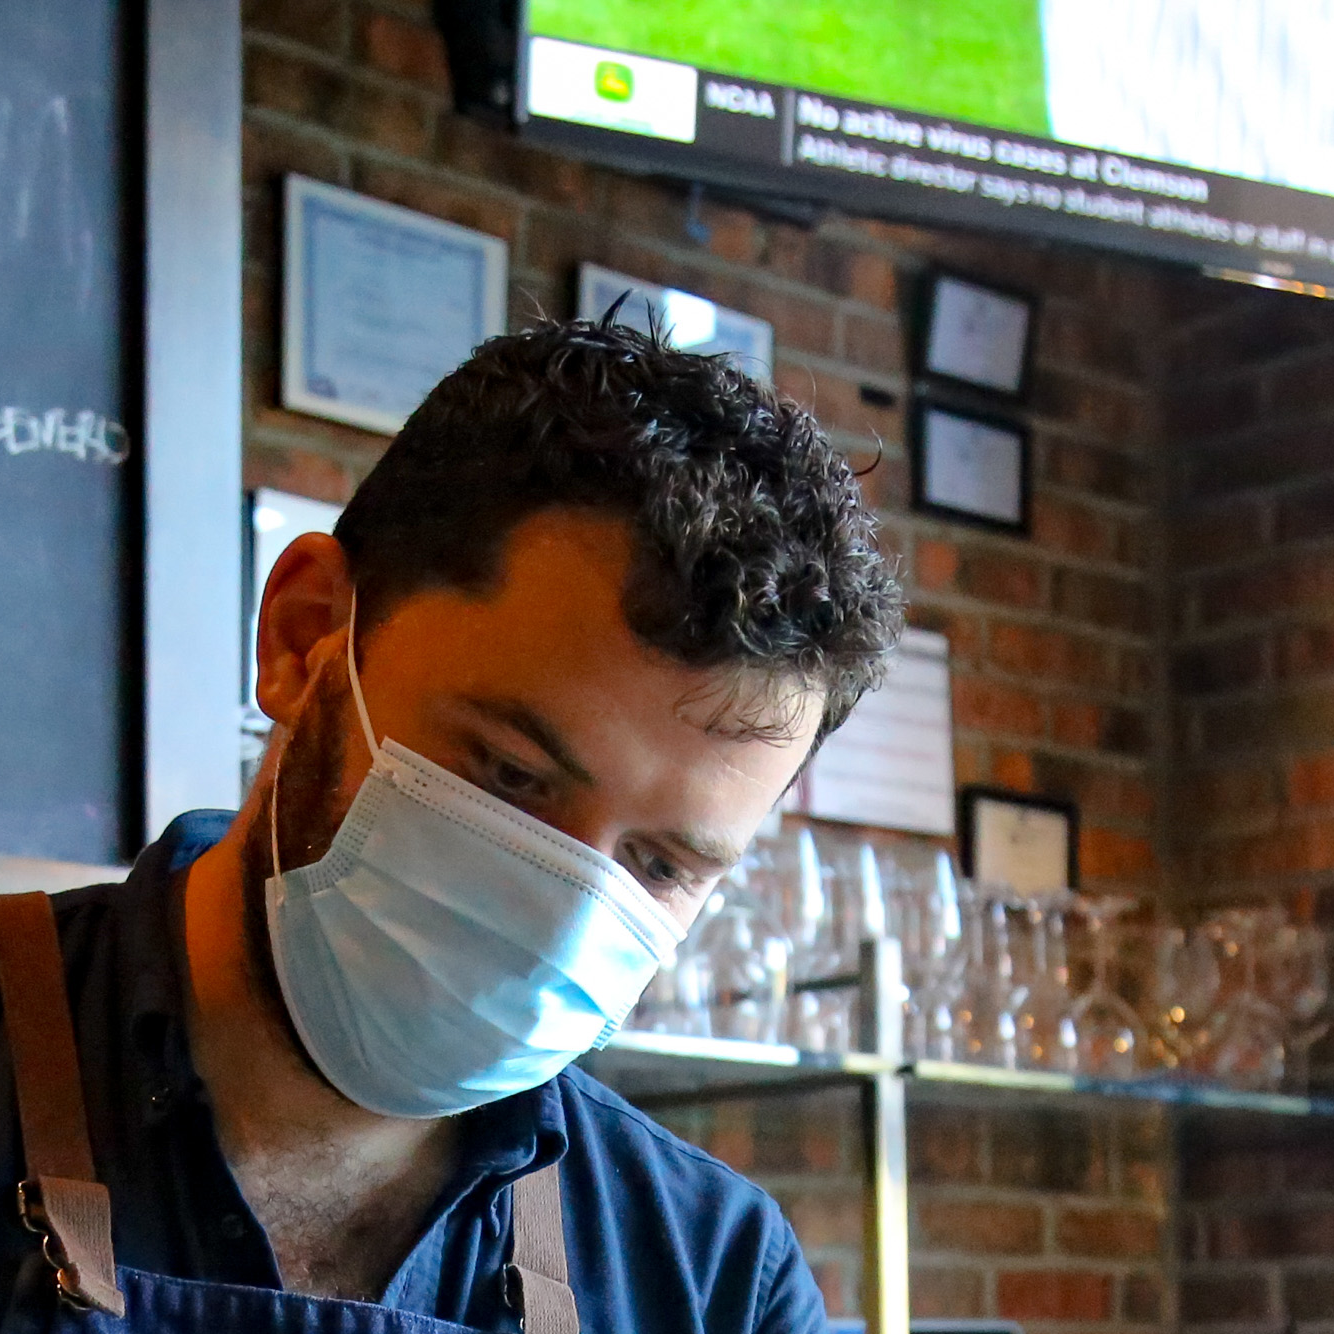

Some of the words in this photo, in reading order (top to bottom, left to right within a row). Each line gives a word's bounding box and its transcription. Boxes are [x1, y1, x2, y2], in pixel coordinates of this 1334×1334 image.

[705, 80, 776, 120] NCAA
[796, 94, 840, 132] No
[841, 109, 924, 149] active
[924, 123, 992, 162] virus
[994, 139, 1067, 177] cases
[1068, 152, 1098, 183] at
[1099, 154, 1209, 204] Clemson
[797, 132, 889, 178] Athletic
[889, 152, 977, 194] director
[977, 173, 1030, 207] says
[1030, 181, 1062, 211] no
[1062, 186, 1145, 227] student
